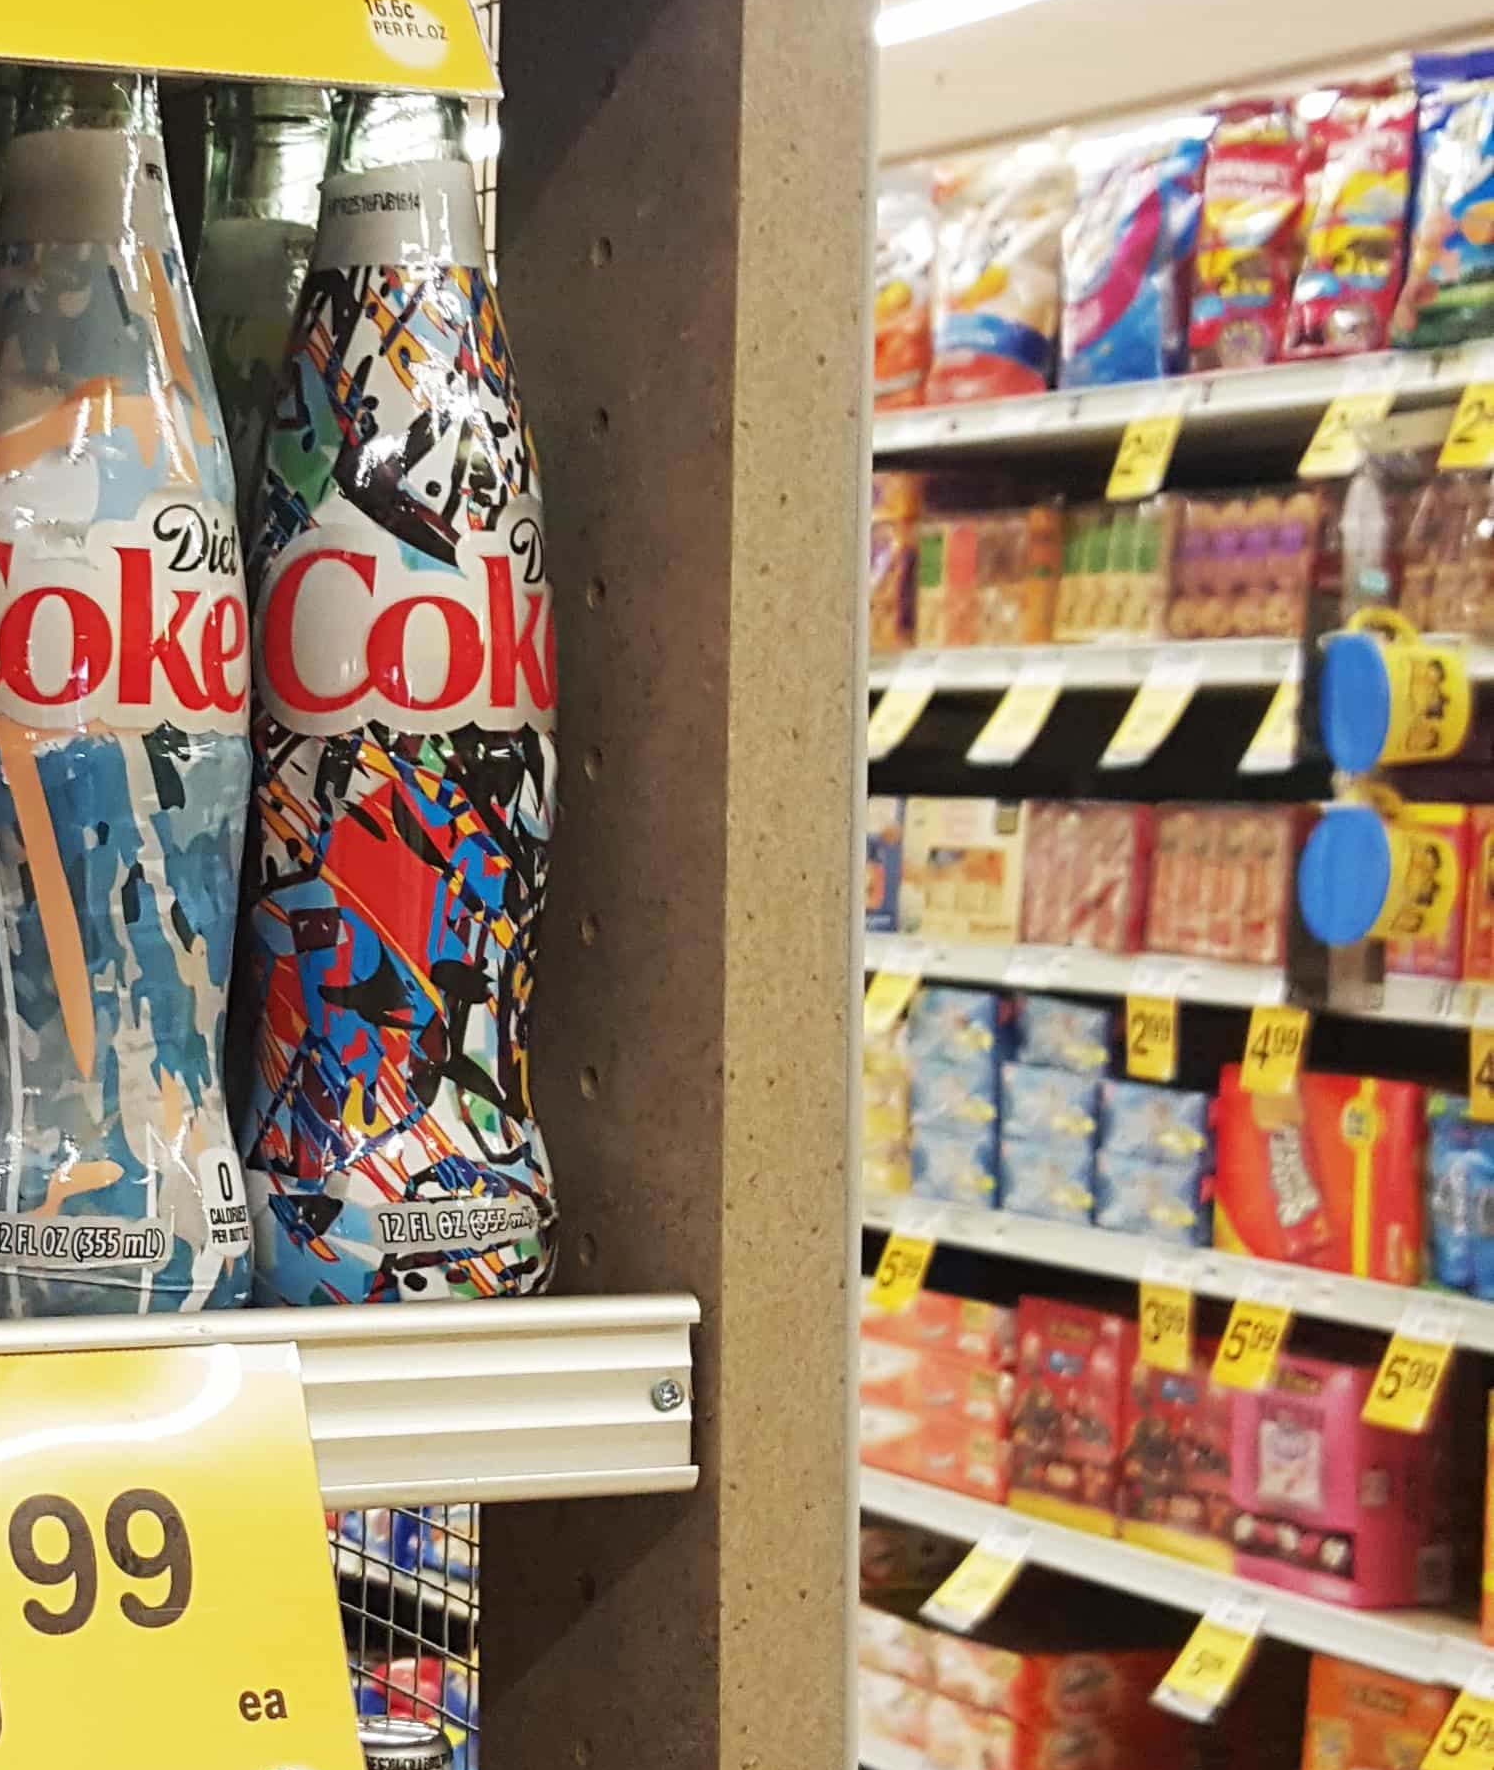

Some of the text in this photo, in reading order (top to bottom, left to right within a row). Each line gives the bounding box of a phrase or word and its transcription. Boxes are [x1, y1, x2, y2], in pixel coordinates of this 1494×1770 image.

[373, 19, 405, 37] PER
[153, 502, 238, 580] Diet
[218, 1161, 233, 1202] 0
[15, 1224, 39, 1257] FL
[42, 1225, 69, 1258] OZ
[72, 1227, 122, 1262] (355
[124, 1227, 166, 1261] mL)
[379, 1212, 406, 1243] 12
[408, 1210, 436, 1242] FL
[437, 1209, 466, 1240] OZ
[239, 1687, 288, 1722] ea
